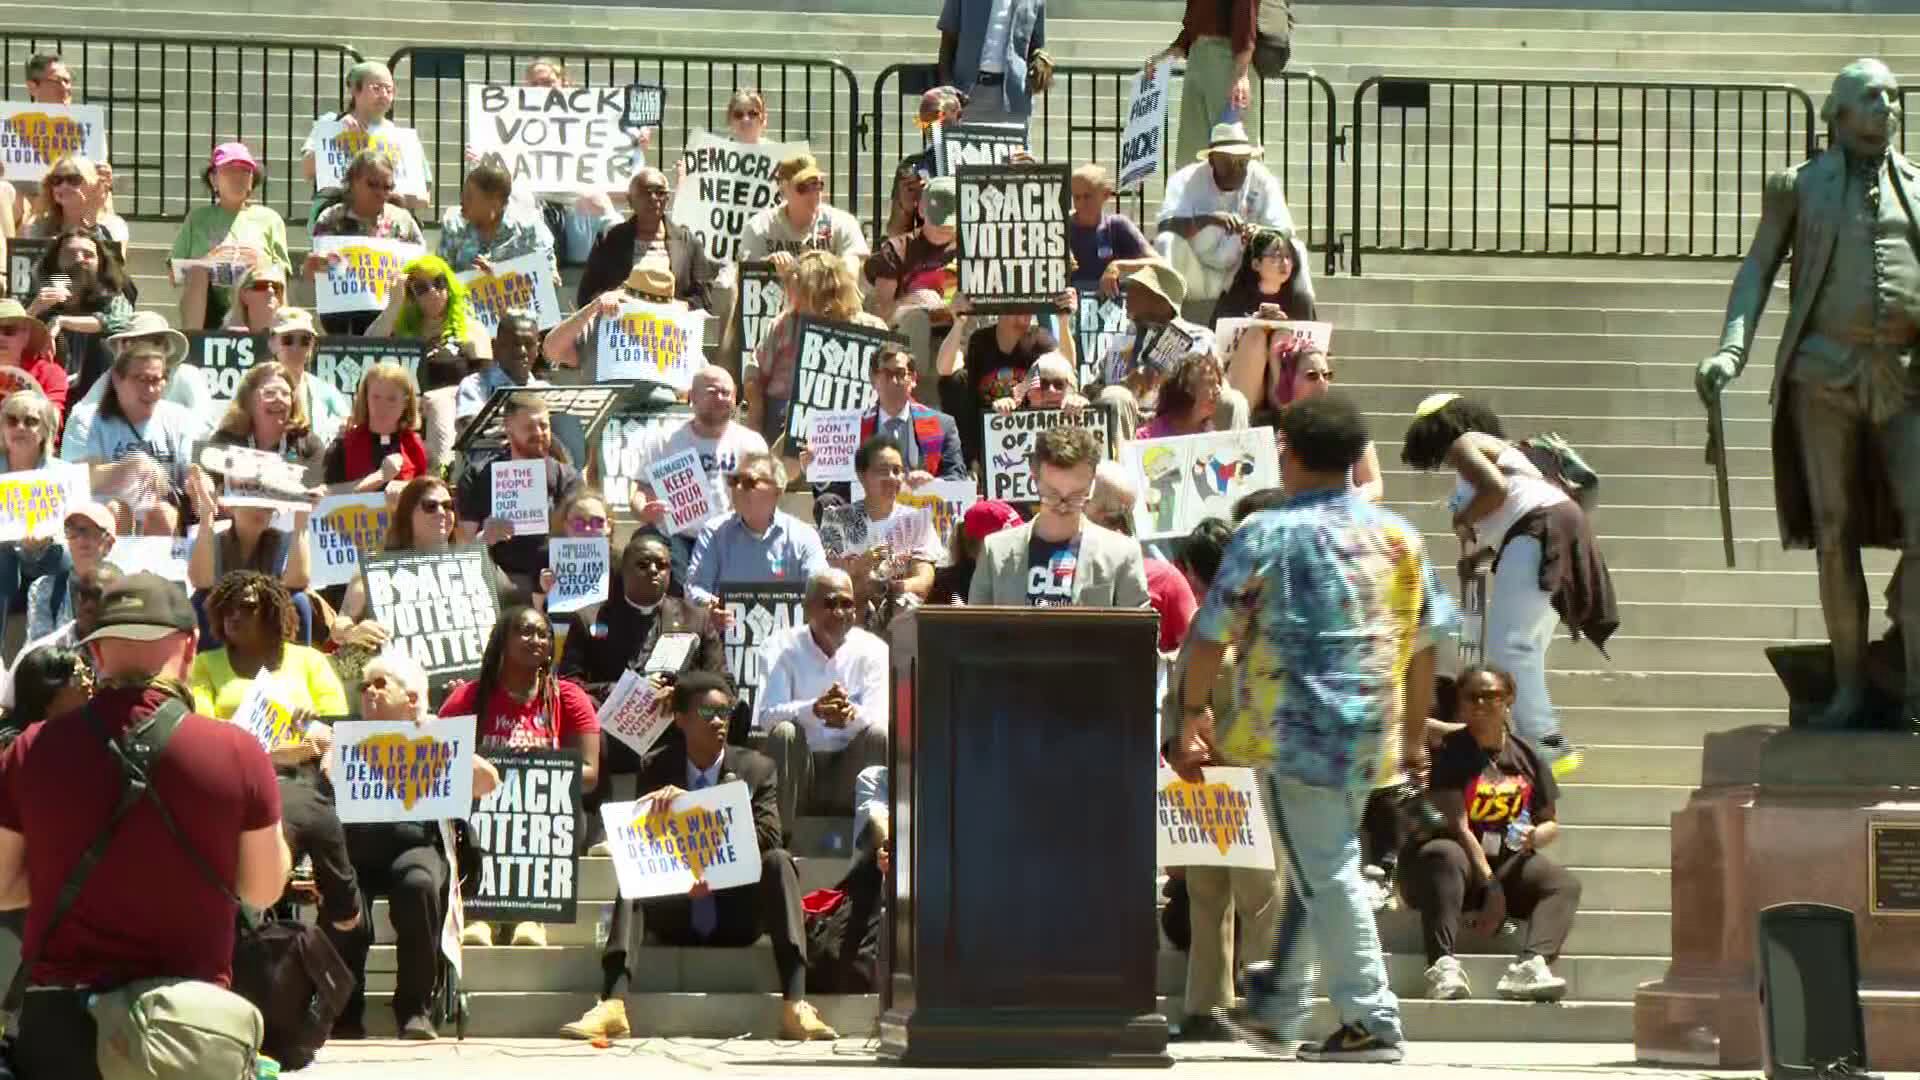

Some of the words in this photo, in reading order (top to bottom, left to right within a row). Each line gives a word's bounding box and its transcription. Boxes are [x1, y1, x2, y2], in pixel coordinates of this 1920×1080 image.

[482, 86, 624, 113] BLACK
[2, 118, 27, 134] HIS
[495, 115, 640, 151] VOTES
[480, 150, 634, 184] MATTER
[685, 147, 784, 182] DEMOCRA
[711, 208, 757, 235] OU
[961, 222, 1065, 257] VOTERS
[961, 259, 1066, 294] MATTER
[204, 337, 255, 367] IT'S
[799, 369, 879, 413] VOTER
[817, 423, 850, 433] DON'T
[833, 433, 856, 444] OUR
[496, 469, 509, 478] WE
[513, 468, 532, 477] THE
[817, 456, 849, 467] MAPS
[496, 479, 534, 489] PEOPLE
[662, 467, 695, 494] KEEP
[496, 489, 518, 499] PICK
[496, 500, 517, 511] OUR
[668, 483, 703, 514] YOUR
[671, 500, 709, 528] WORD
[327, 547, 355, 566] LOO
[555, 562, 577, 574] NO
[581, 560, 604, 574] JIM
[558, 573, 600, 585] CROW
[559, 583, 600, 595] MAPS
[341, 744, 379, 761] THIS
[389, 744, 405, 760] IS
[416, 740, 459, 761] WHAT
[346, 760, 452, 781] DEMOCRACY
[351, 780, 405, 800] LOOKS
[416, 778, 451, 800] LIKE
[481, 768, 574, 814] ACK
[1158, 790, 1184, 807] HIS
[1192, 790, 1207, 806] IS
[1214, 790, 1252, 808] WHAT
[617, 821, 654, 841] THIS
[661, 818, 678, 836] IS
[687, 806, 733, 832] WHAT
[1159, 808, 1249, 826] DEMOCRACY
[470, 813, 574, 856] OTERS
[628, 827, 730, 858] DEMOCRACY
[1168, 827, 1217, 845] LOOKS
[1224, 827, 1254, 847] LIKE
[637, 854, 691, 876] LOOKS
[700, 845, 737, 868] LIKE
[478, 855, 574, 899] ATTER
